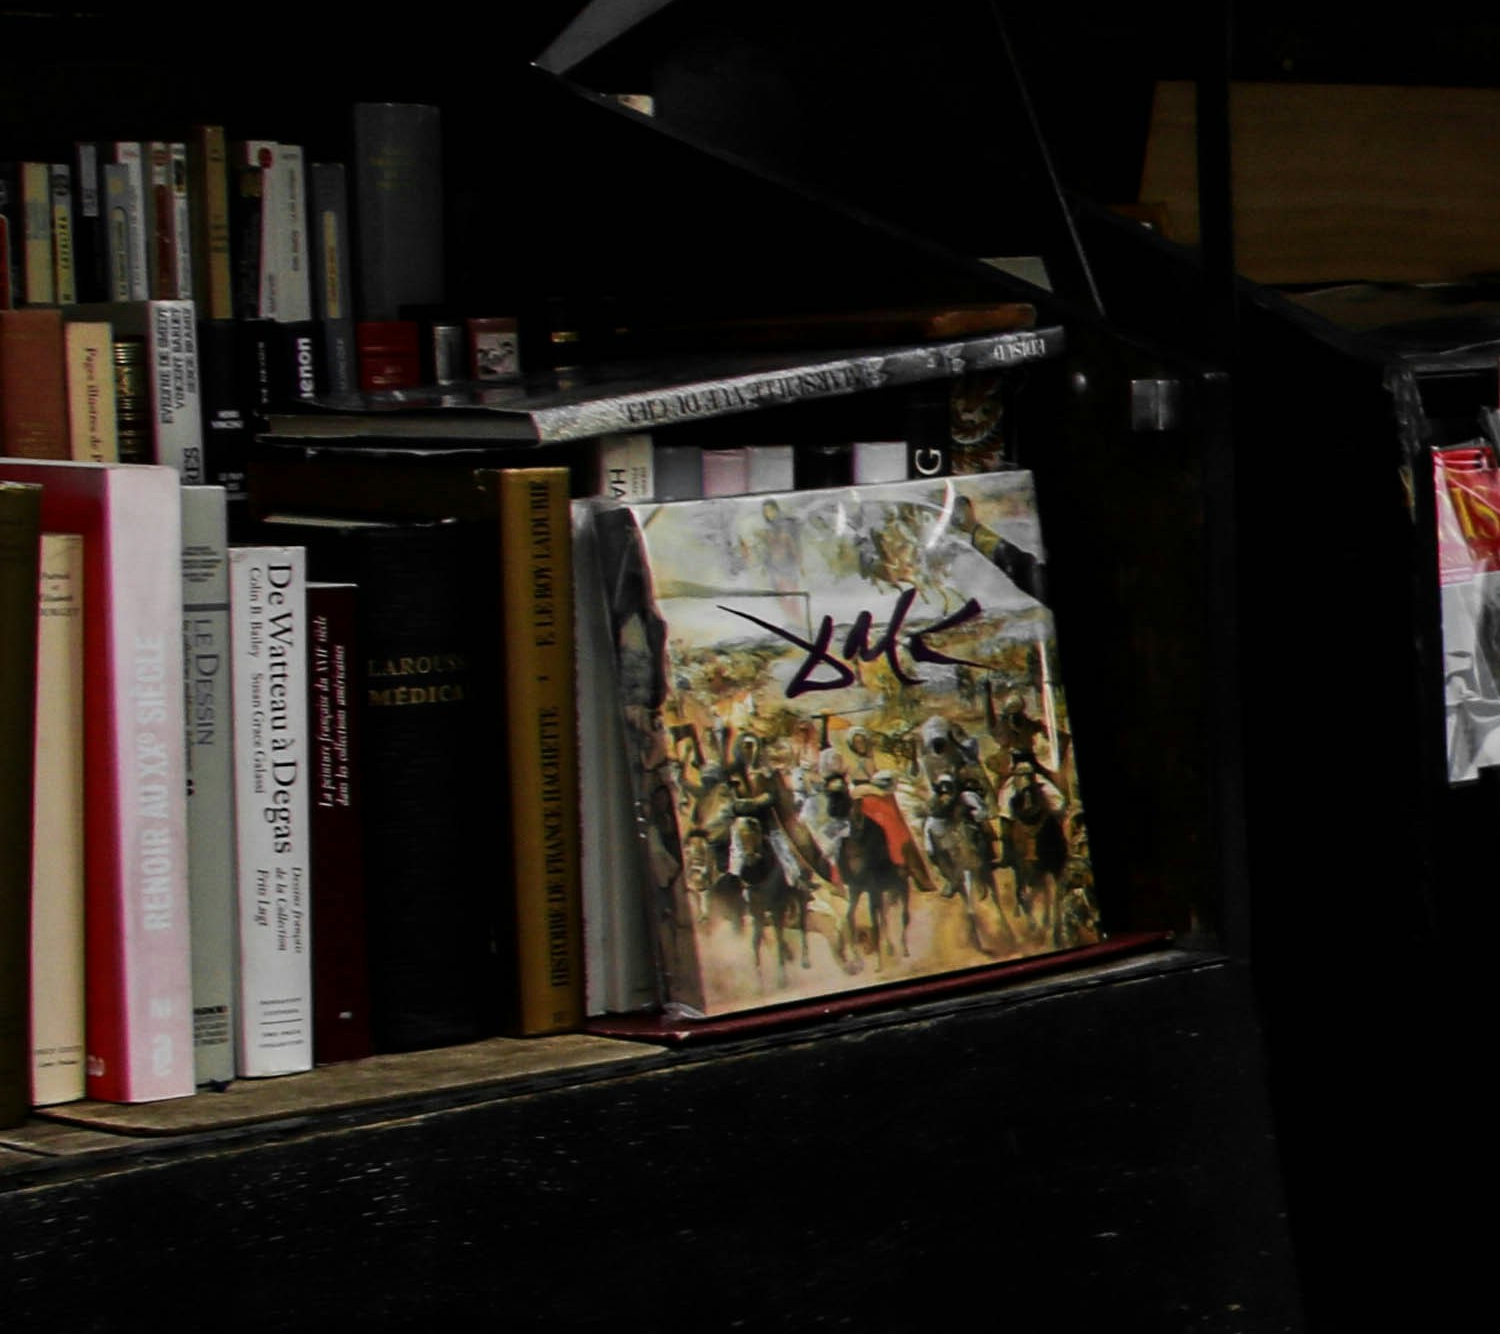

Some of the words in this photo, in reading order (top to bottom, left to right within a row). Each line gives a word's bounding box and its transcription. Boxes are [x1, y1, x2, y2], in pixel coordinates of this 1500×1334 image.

[527, 480, 552, 561] LADURIE
[249, 567, 265, 602] Colin
[266, 564, 293, 605] De
[193, 619, 214, 647] LE
[247, 621, 266, 659] Bailey
[312, 614, 328, 644] siècle
[131, 632, 168, 725] SIÈCLE
[251, 672, 267, 708] Susan
[267, 611, 295, 731] Watteau
[314, 675, 330, 692] du
[251, 711, 268, 749] Grace
[314, 694, 333, 742] française
[332, 708, 349, 762] collections
[270, 738, 294, 752] à
[537, 706, 563, 804] HACHETTE
[252, 750, 268, 794] Galassi
[316, 744, 336, 789] peinture
[333, 764, 349, 779] les
[139, 783, 169, 820] AU
[263, 760, 298, 855] Degas
[318, 790, 335, 808] La
[334, 781, 350, 807] dans
[541, 807, 566, 876] FRANCE
[143, 826, 174, 931] RENOIR
[255, 868, 270, 897] Frits
[274, 866, 287, 881] de
[275, 883, 288, 895] la
[543, 879, 568, 904] DE
[253, 900, 272, 927] Lugt
[275, 898, 289, 952] Collection
[290, 909, 305, 955] français
[544, 908, 571, 988] HISTOIRE
